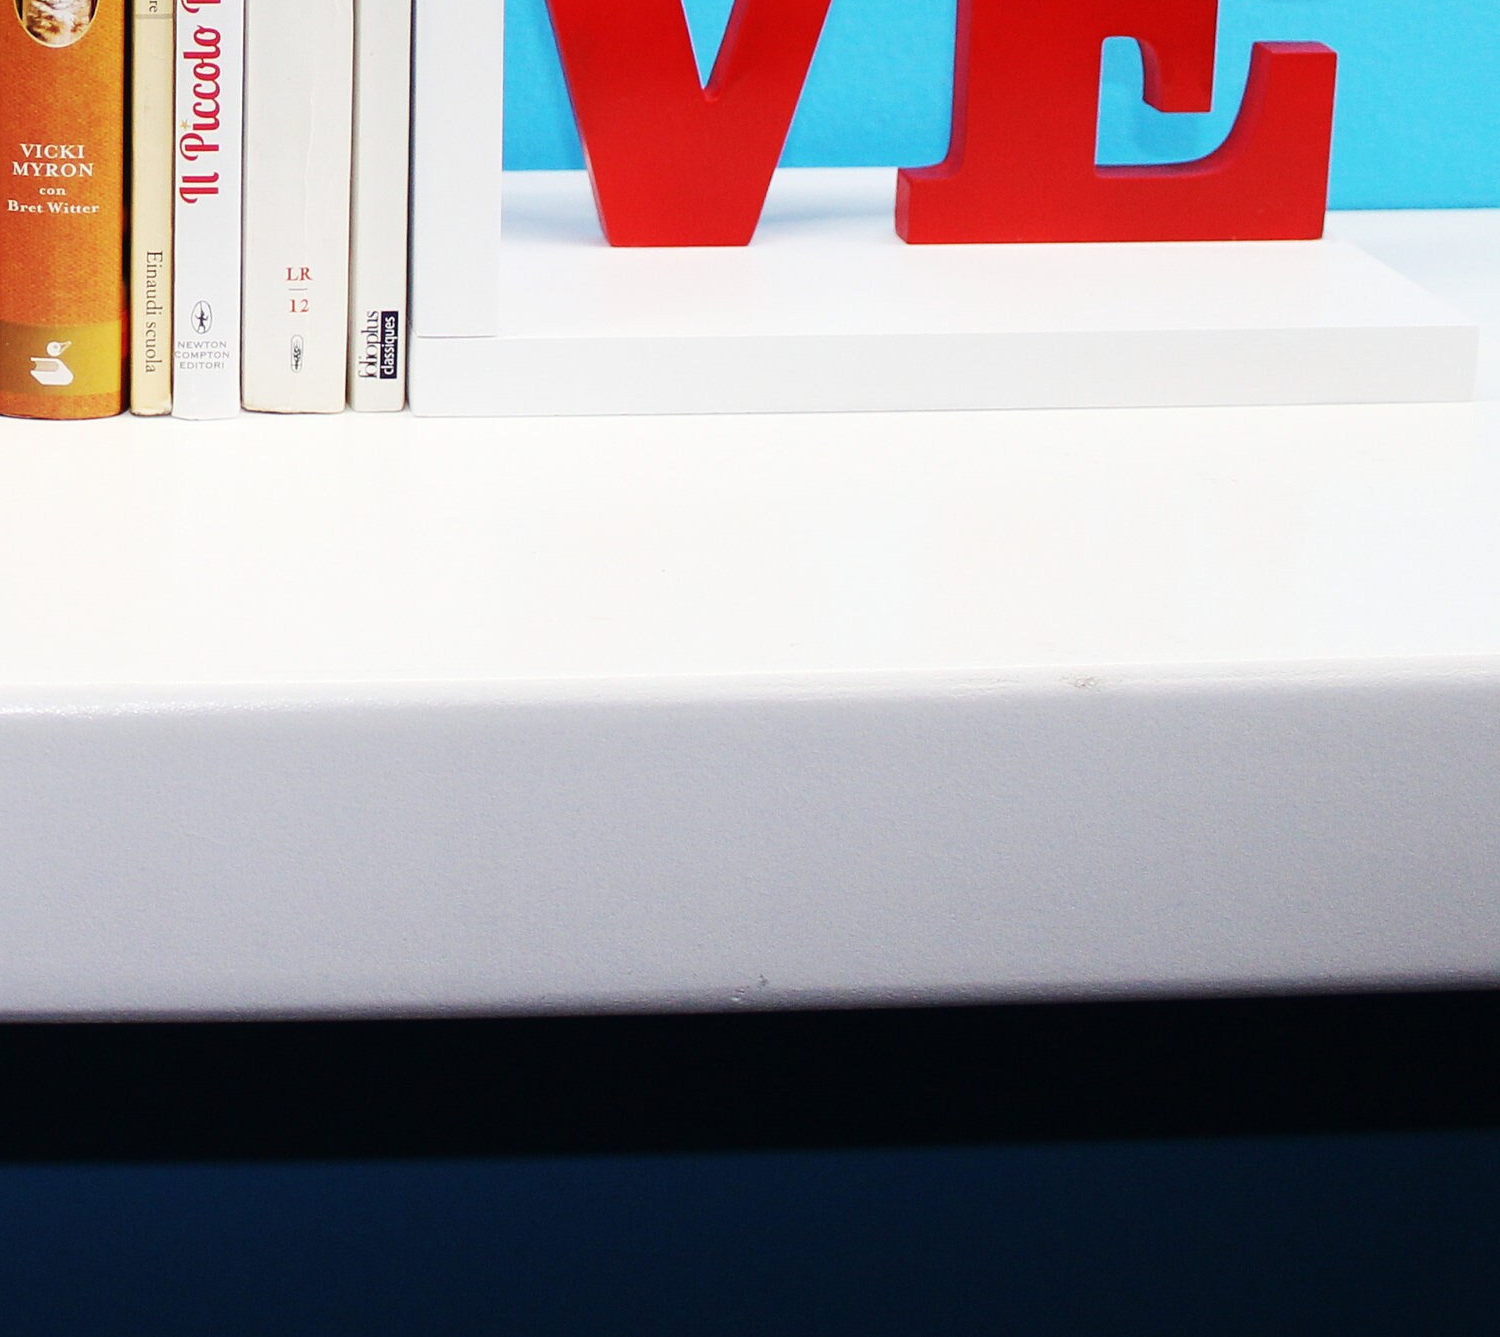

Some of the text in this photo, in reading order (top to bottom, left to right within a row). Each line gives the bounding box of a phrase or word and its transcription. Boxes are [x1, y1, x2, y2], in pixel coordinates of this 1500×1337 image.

[179, 25, 221, 161] Piccolo
[19, 143, 85, 159] VICKI
[12, 162, 94, 177] MYRON
[39, 186, 66, 196] con
[179, 172, 219, 204] Il
[7, 200, 100, 214] Bret Witter
[285, 267, 313, 281] LR
[145, 250, 163, 373] Einaudi scuola
[290, 299, 309, 313] 12
[177, 341, 227, 349] NEWTON
[358, 310, 382, 378] folioplus
[380, 315, 398, 375] classiques
[174, 351, 230, 359] COMPTON
[179, 361, 225, 369] EDITORI
